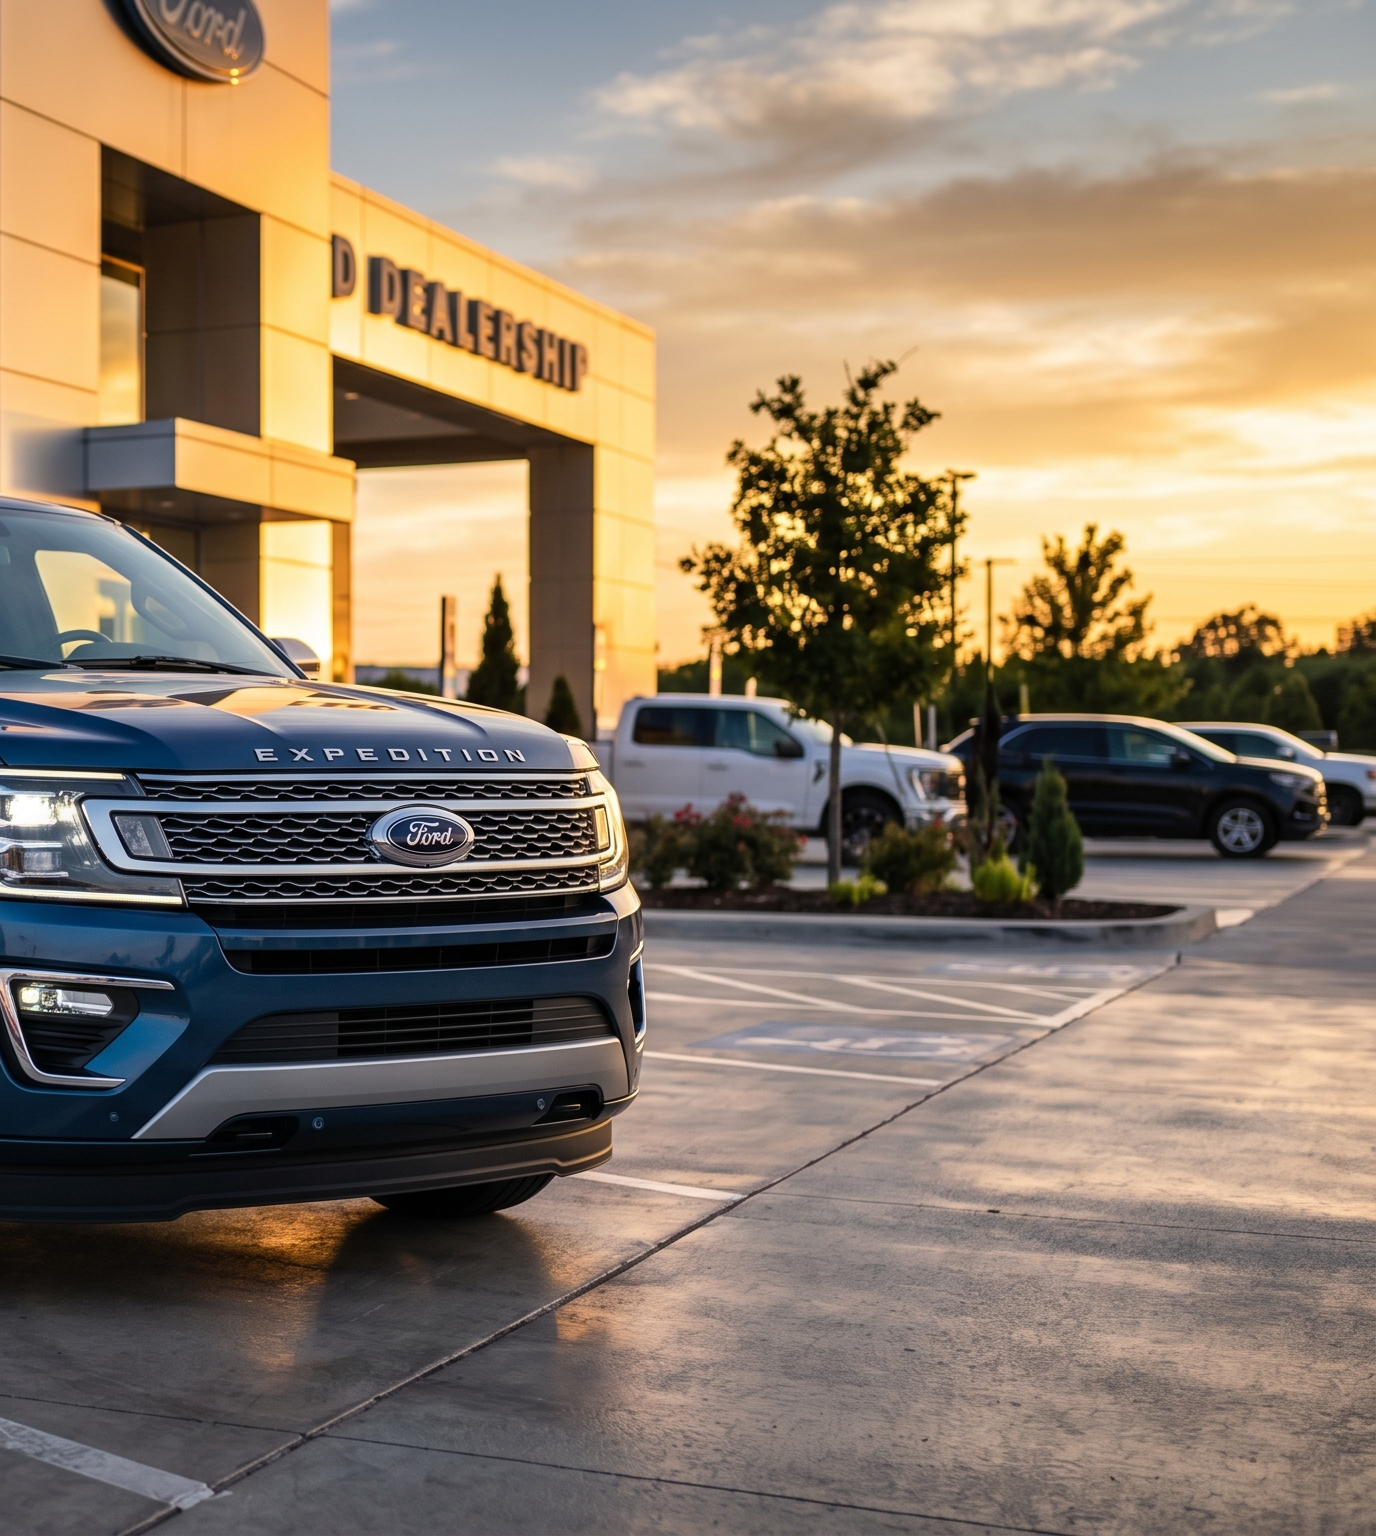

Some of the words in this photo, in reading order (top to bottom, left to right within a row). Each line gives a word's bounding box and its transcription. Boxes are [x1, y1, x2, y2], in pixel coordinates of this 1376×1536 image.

[367, 255, 589, 392] DEALERSHIP
[254, 748, 526, 762] EXPEDITION
[406, 821, 454, 846] Ford
